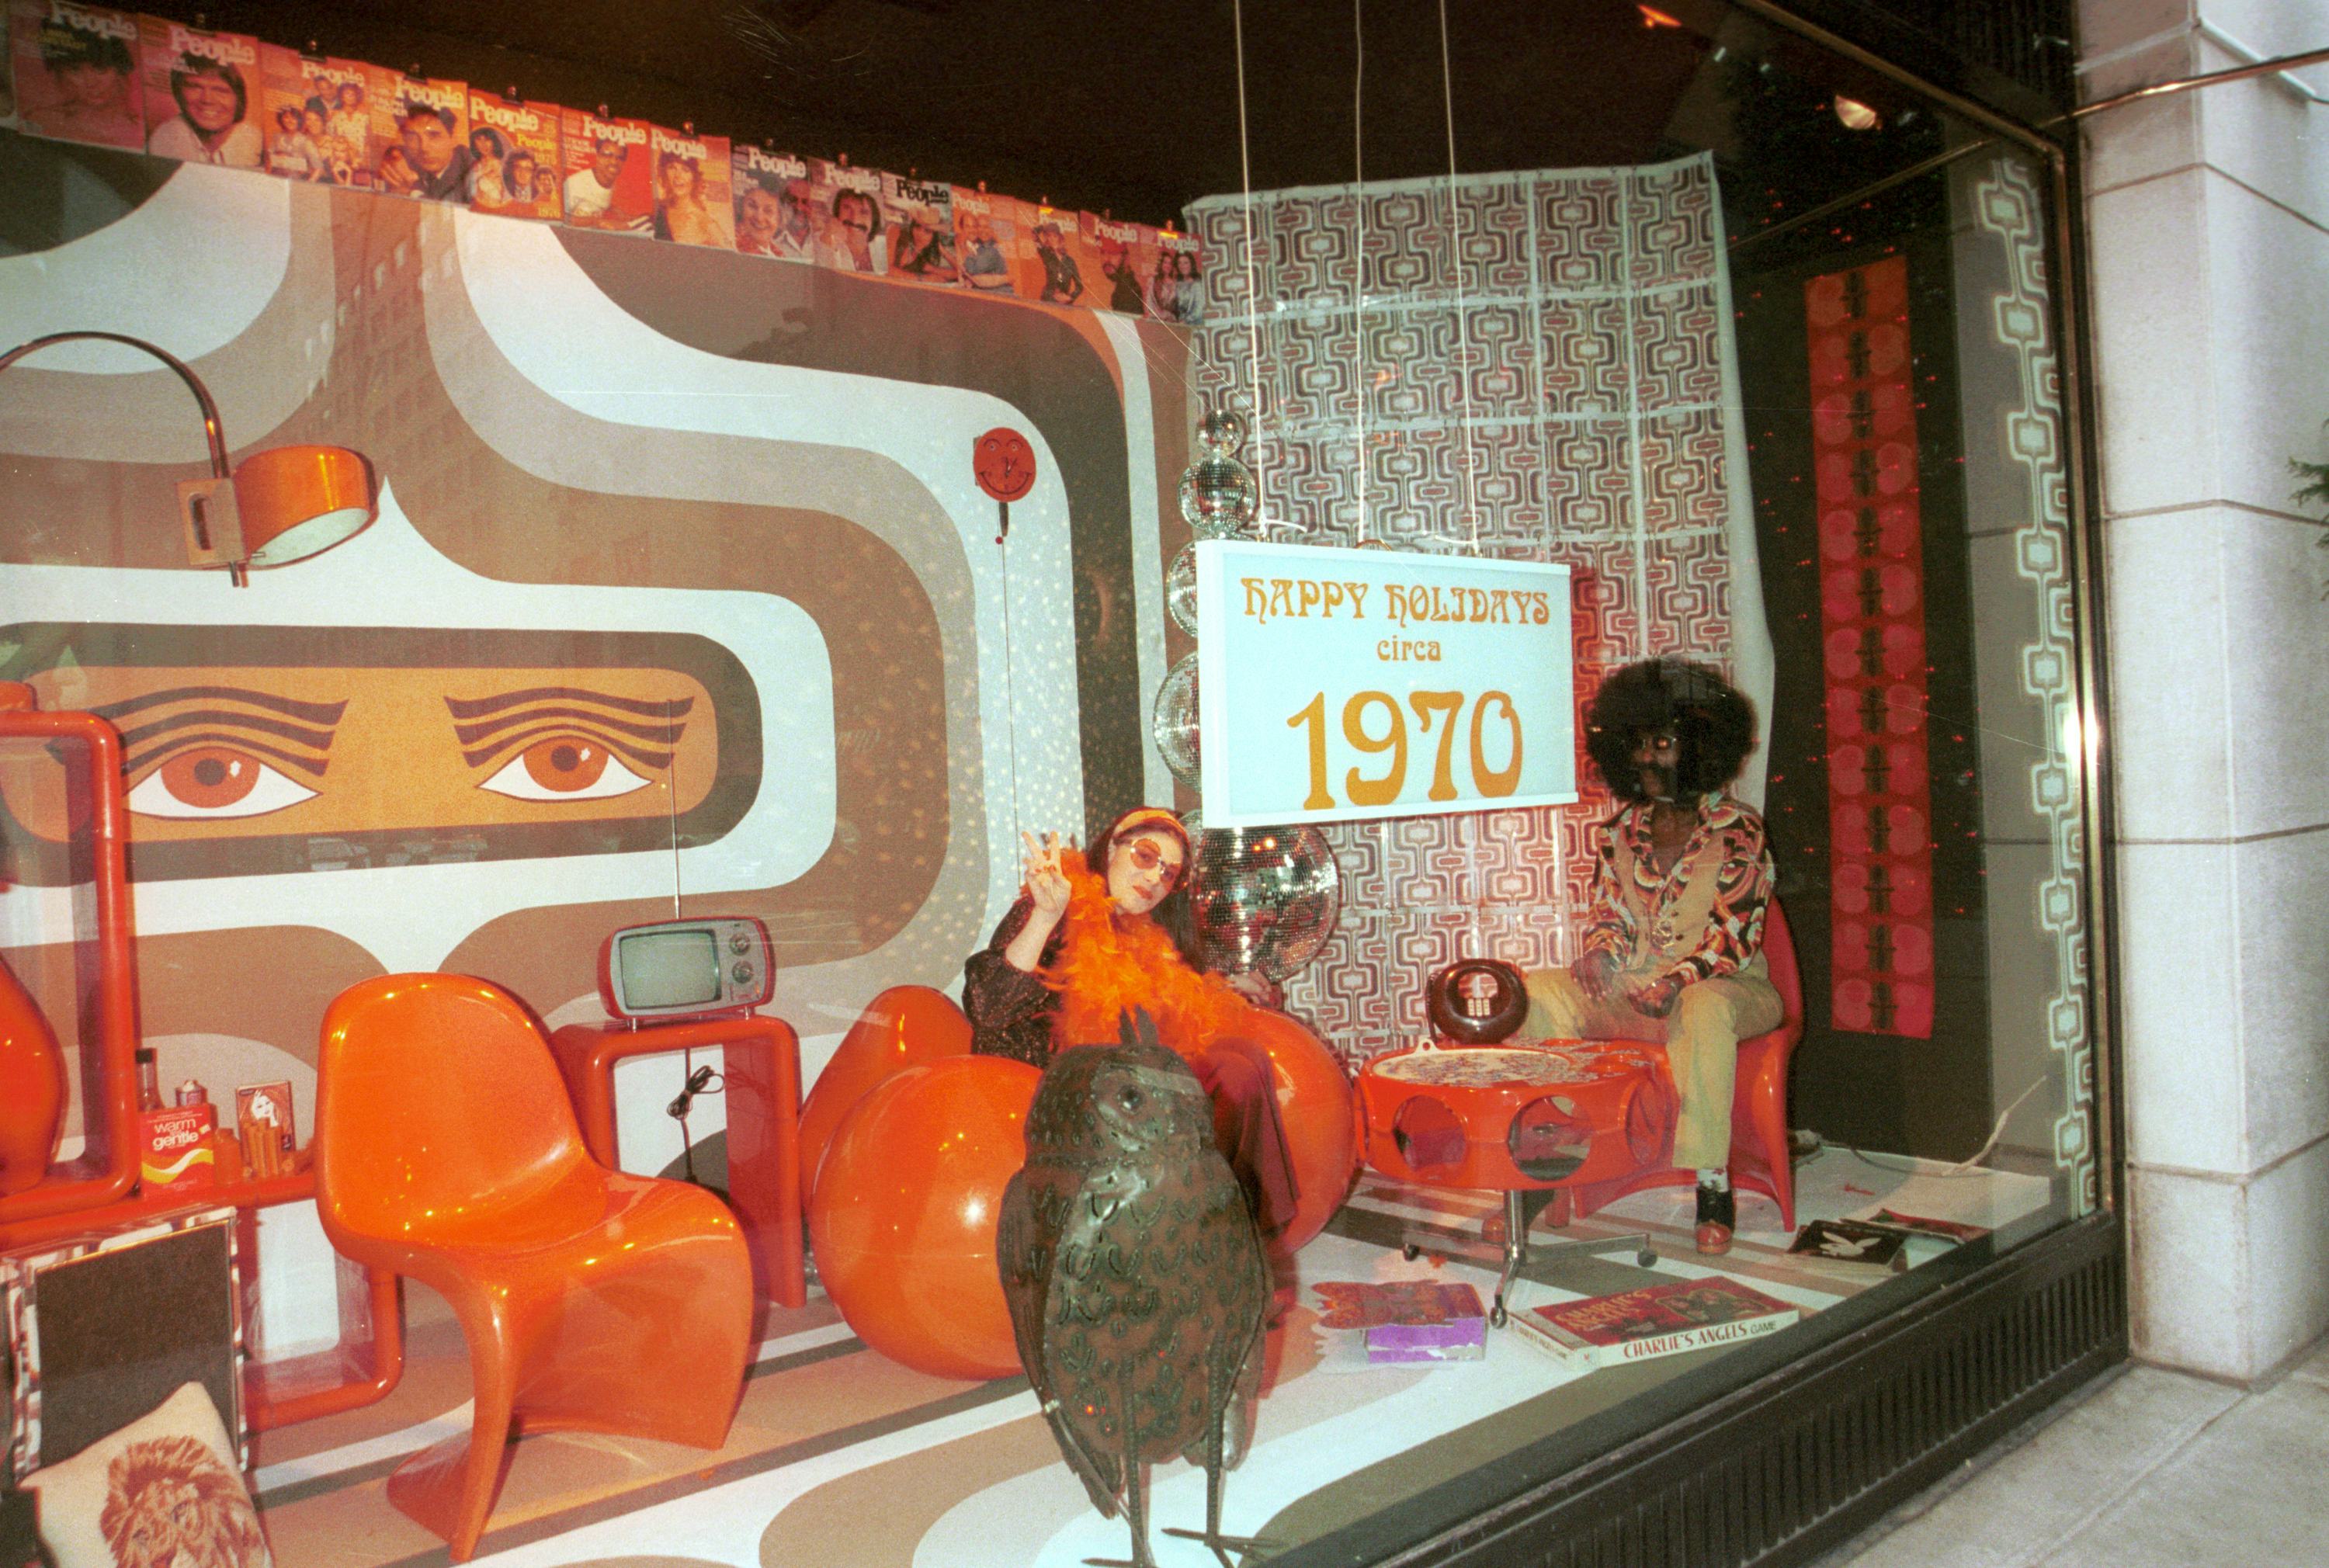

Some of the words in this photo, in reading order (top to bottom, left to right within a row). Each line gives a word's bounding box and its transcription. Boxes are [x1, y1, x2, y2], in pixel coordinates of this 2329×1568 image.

[51, 0, 137, 40] People
[168, 24, 256, 67] People
[301, 61, 365, 87] People
[394, 75, 465, 111] People
[469, 95, 539, 132] People
[517, 133, 557, 150] People
[583, 116, 647, 147] People
[651, 127, 707, 161] People
[748, 146, 807, 179] People
[824, 163, 881, 193] People
[896, 179, 949, 206] People
[951, 192, 991, 216] People
[1094, 217, 1138, 244] People
[1156, 232, 1199, 254] People
[1241, 577, 1369, 625] HAPPY
[1384, 582, 1550, 628] HOLIDAYS
[1376, 634, 1442, 661] circa
[1286, 690, 1523, 811] 1970
[152, 1129, 200, 1151] gentle
[154, 1118, 196, 1134] warm
[1623, 1332, 1694, 1358] CHARLIE'S
[1698, 1322, 1748, 1345] ANGELS
[1750, 1320, 1777, 1334] GAME
